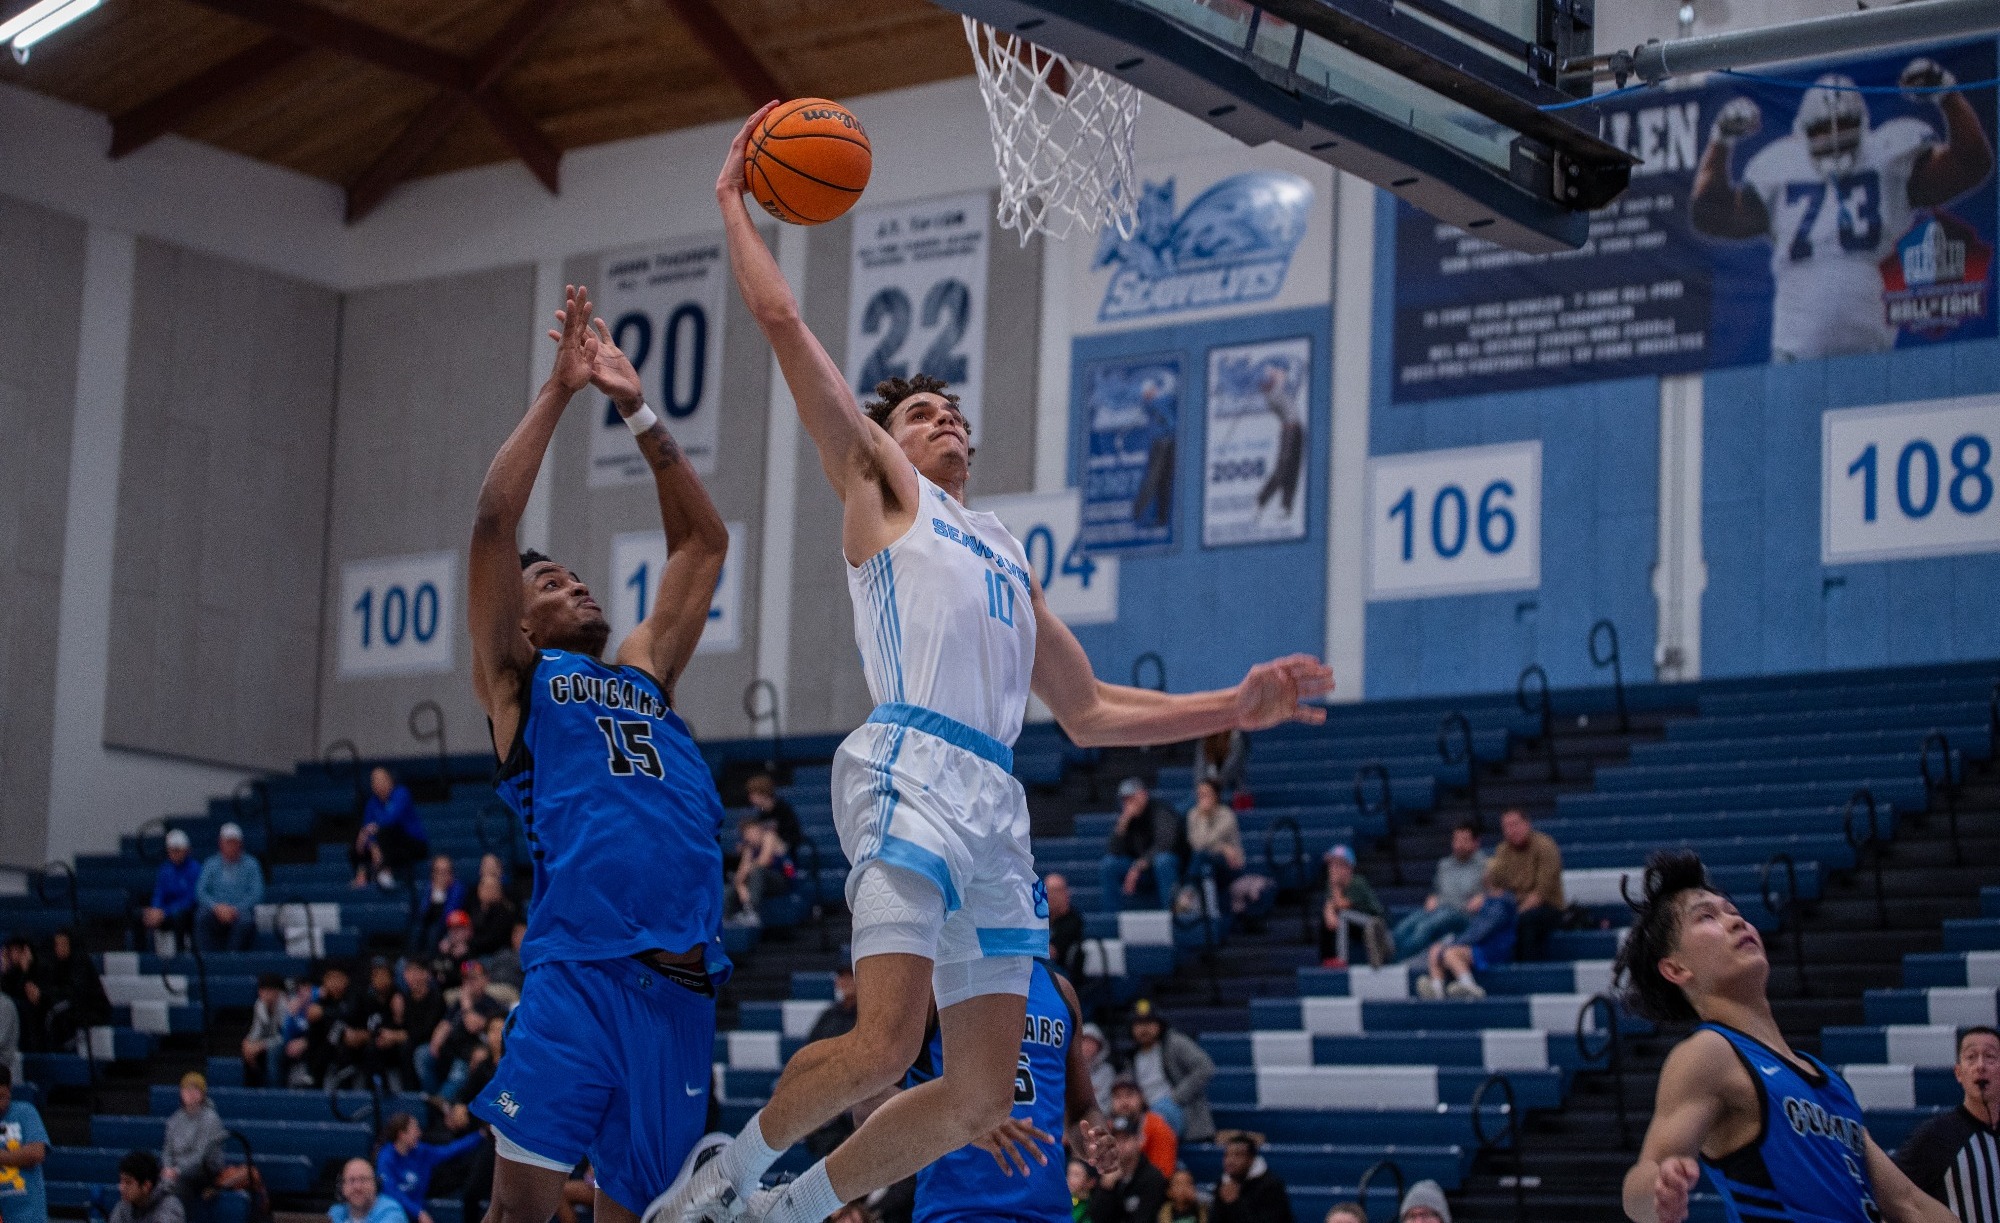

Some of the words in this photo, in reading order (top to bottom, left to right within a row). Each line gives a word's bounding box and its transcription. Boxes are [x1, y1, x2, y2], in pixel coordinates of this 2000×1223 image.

[1599, 102, 1699, 177] LEN
[1785, 170, 1882, 261] 73
[857, 277, 973, 396] 22
[1848, 434, 1995, 523] 108
[1388, 478, 1517, 562] 106
[1025, 523, 1097, 592] 04
[353, 581, 440, 649] 100
[985, 568, 1015, 629] 10
[549, 672, 670, 721] COUGARS
[595, 716, 666, 781] 15
[496, 1091, 521, 1118] SM
